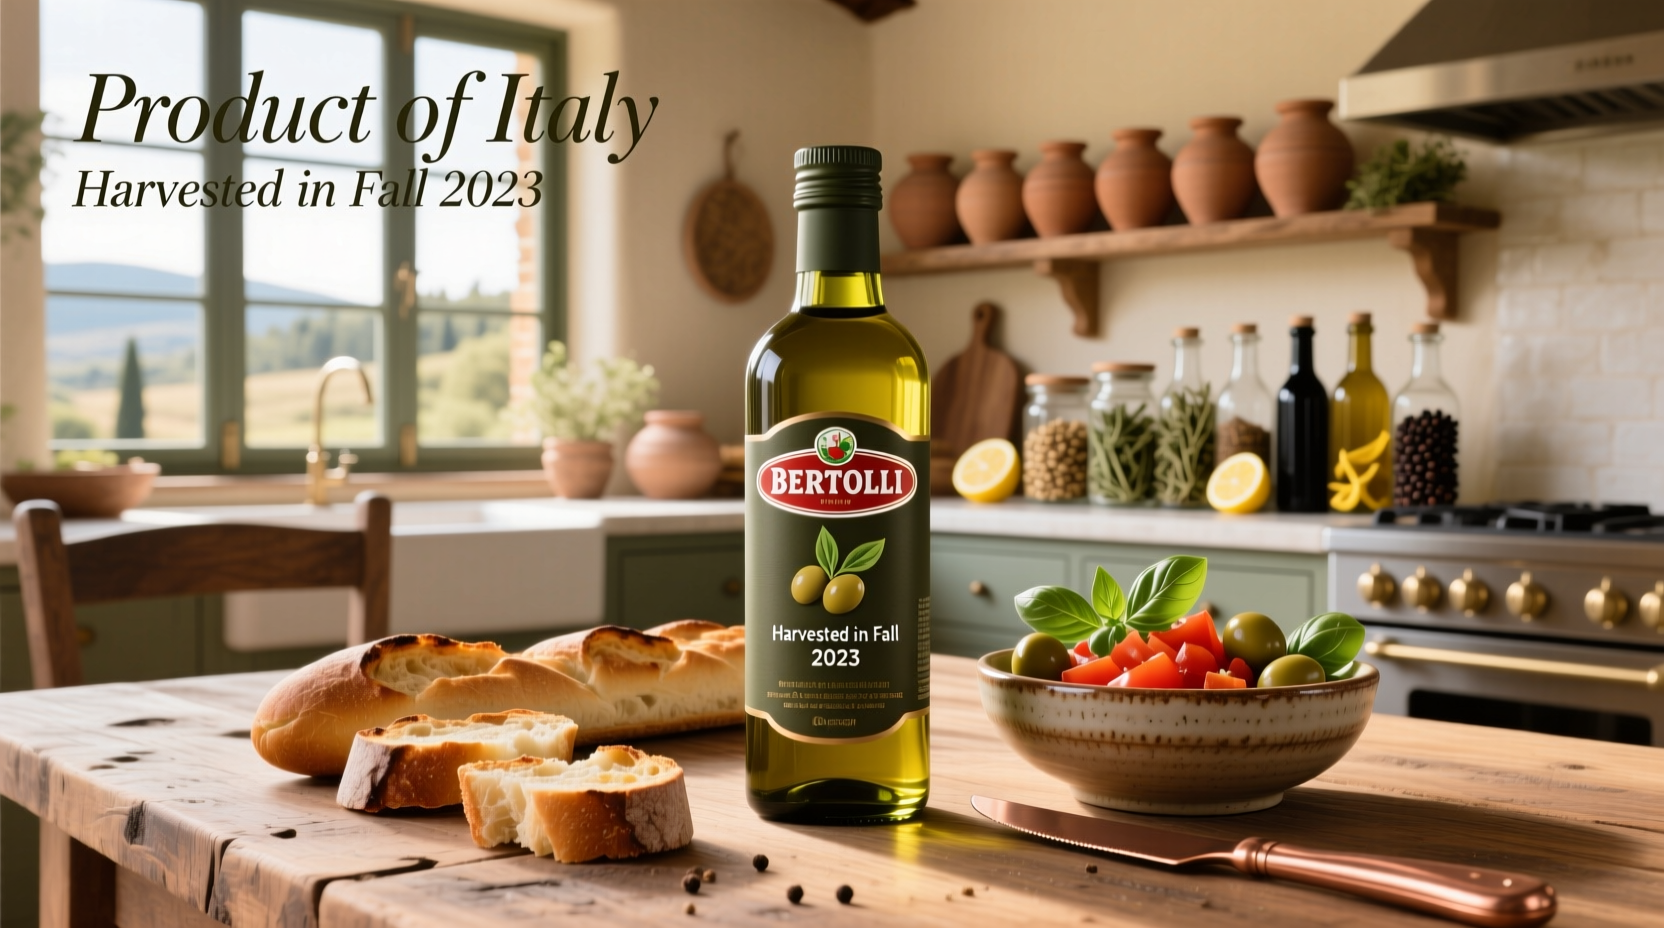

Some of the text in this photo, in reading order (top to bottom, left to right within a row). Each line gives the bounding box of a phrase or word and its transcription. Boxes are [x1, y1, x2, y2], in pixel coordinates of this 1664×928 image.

[770, 466, 903, 495] BERTOLLI
[772, 624, 899, 642] Harvested in Fall
[811, 648, 860, 667] 2023
